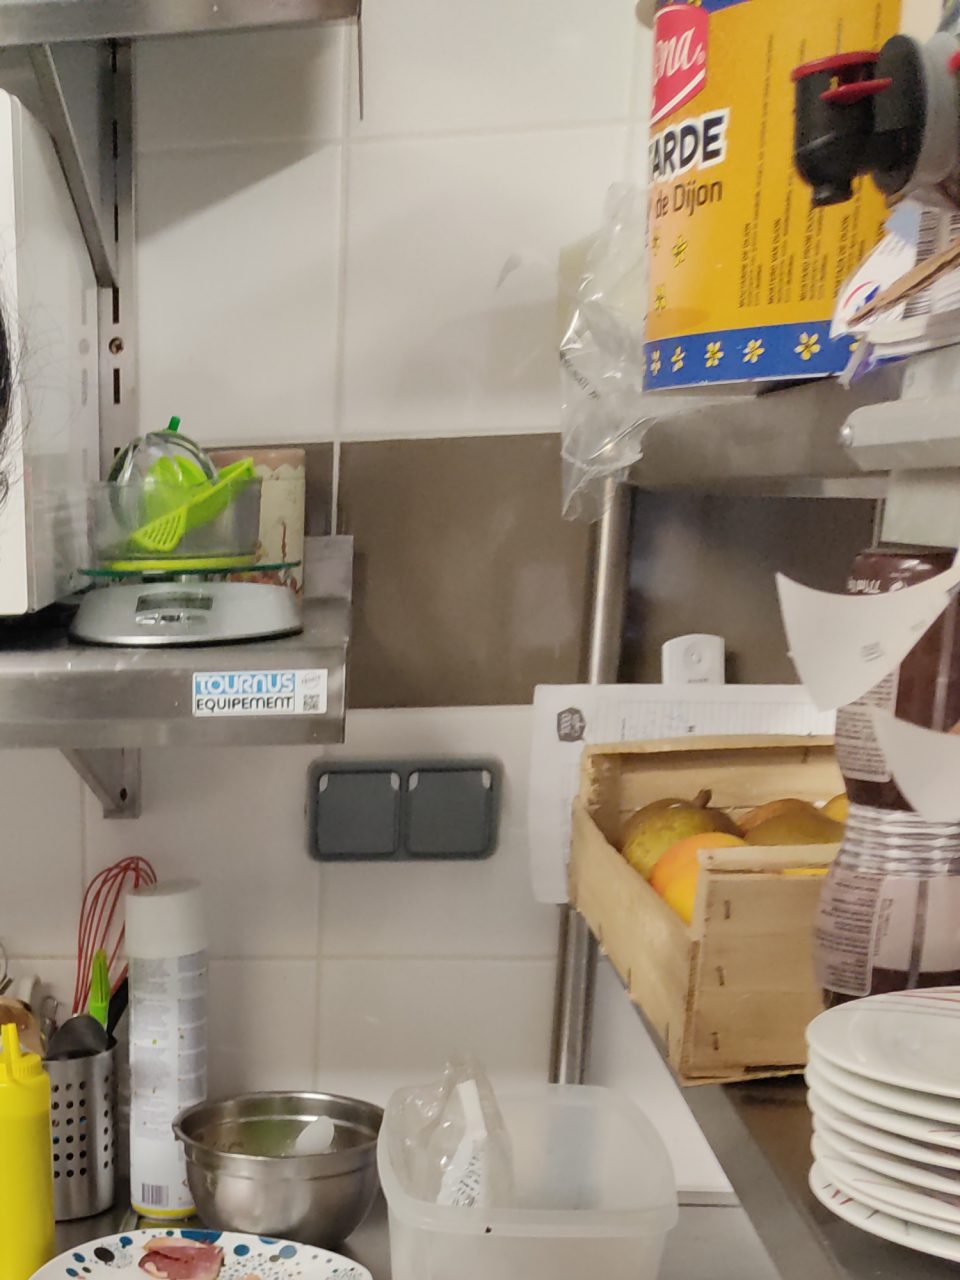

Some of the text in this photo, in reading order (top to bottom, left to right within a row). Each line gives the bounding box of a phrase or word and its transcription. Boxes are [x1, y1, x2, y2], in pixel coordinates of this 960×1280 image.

[650, 115, 725, 182] ARDE
[656, 180, 723, 220] de Dijon
[196, 673, 295, 695] TOURNUS
[196, 696, 293, 713] EQUIPEMENT
